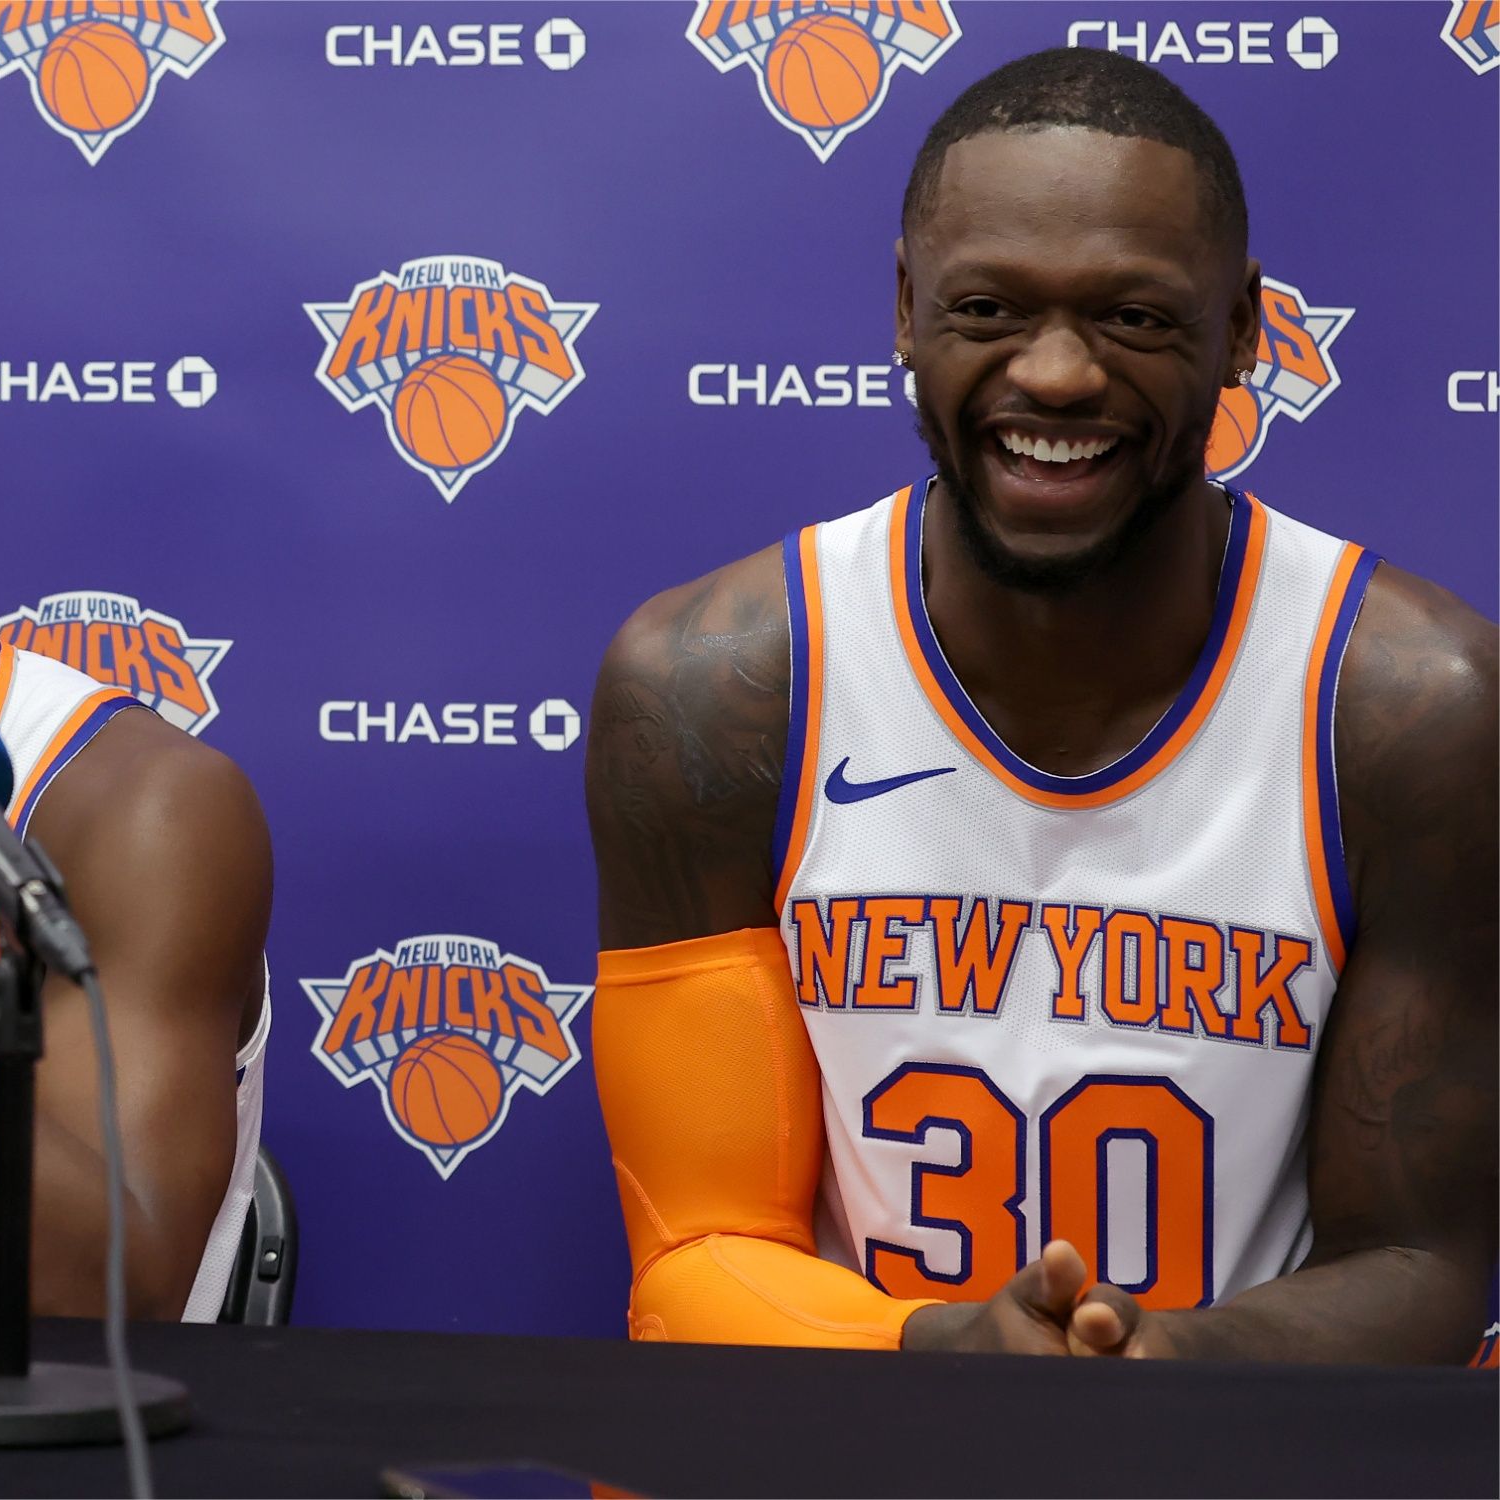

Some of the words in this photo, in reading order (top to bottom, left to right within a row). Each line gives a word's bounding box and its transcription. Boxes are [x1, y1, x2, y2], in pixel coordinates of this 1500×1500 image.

[325, 25, 523, 66] CHASE
[401, 262, 445, 287] NEW
[450, 262, 501, 288] YORK
[326, 283, 576, 380] KNICKS
[688, 364, 892, 407] CHASE
[40, 599, 81, 623] NEW
[87, 598, 137, 624] YORK
[319, 701, 518, 745] CHASE
[397, 941, 440, 965] NEW
[446, 941, 498, 967] YORK
[791, 894, 1033, 1016] NEW
[1040, 904, 1316, 1051] YORK
[321, 961, 571, 1062] KNICKS
[862, 1061, 1215, 1309] 30
